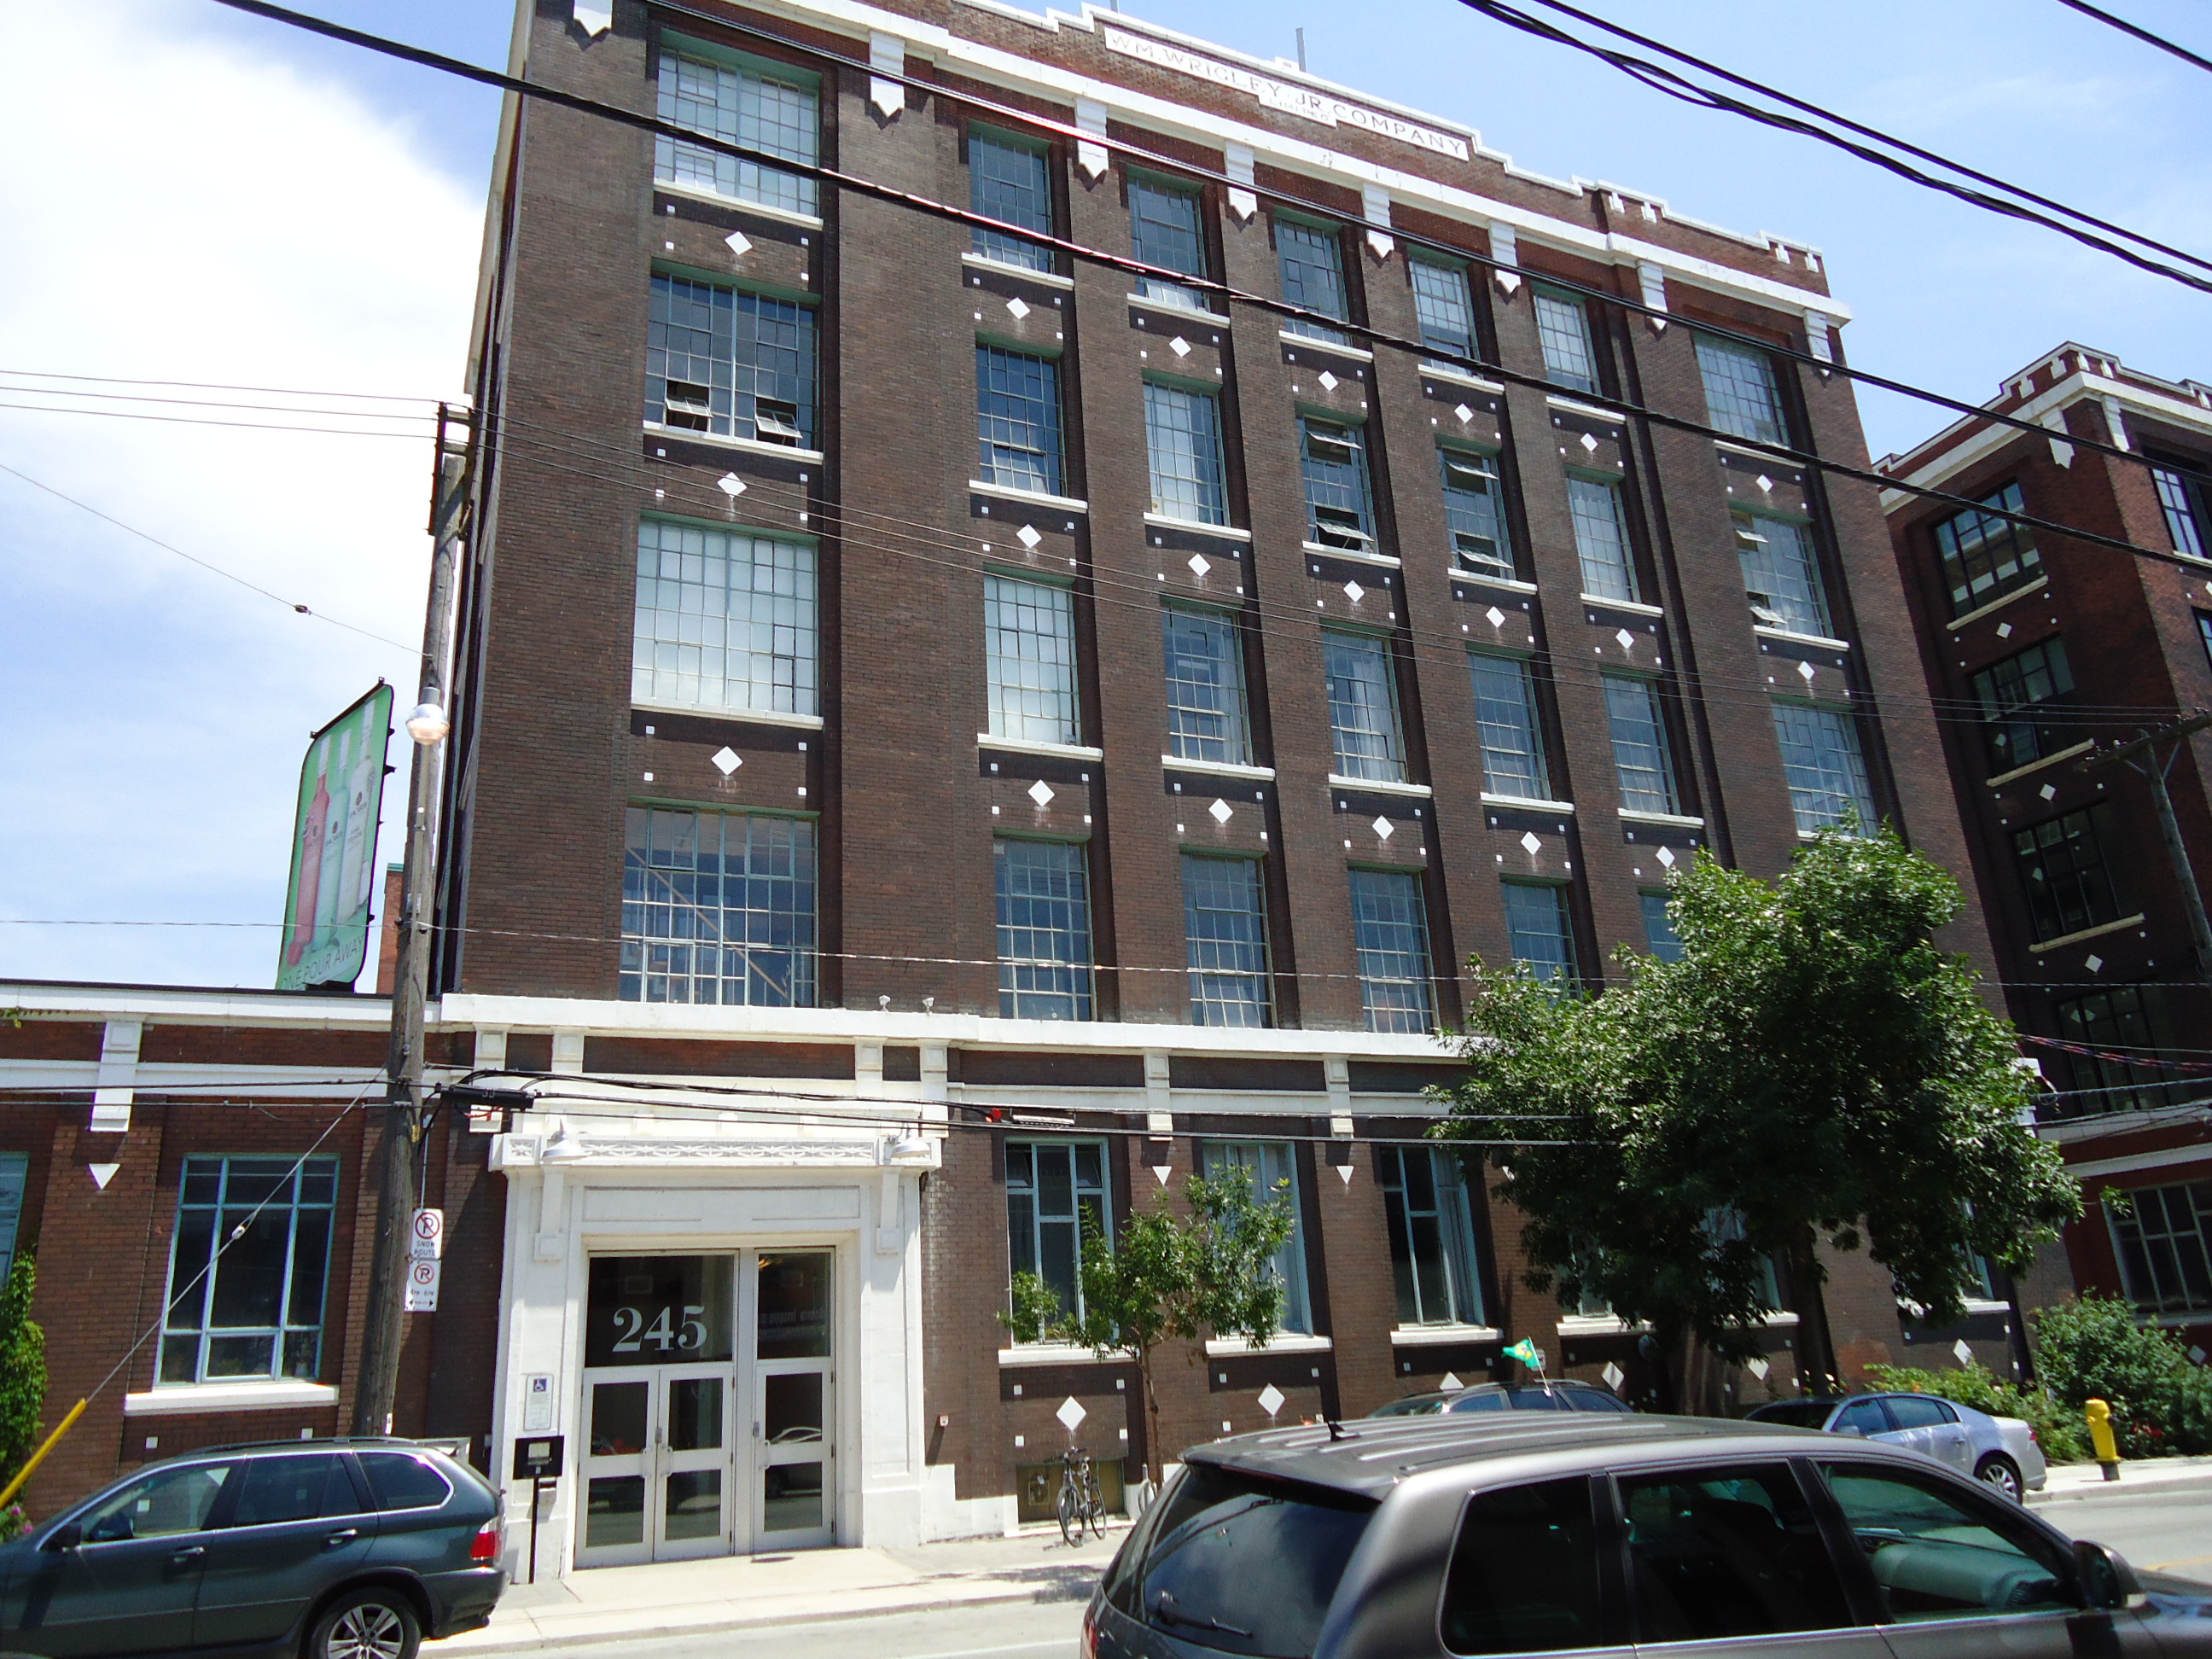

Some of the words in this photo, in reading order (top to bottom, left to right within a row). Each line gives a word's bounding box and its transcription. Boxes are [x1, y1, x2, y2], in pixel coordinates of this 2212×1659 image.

[1333, 103, 1462, 155] COMPANY
[303, 953, 332, 980] POUR
[334, 933, 365, 965] AWAY
[414, 1249, 435, 1257] ROUTE
[612, 1305, 707, 1353] 245
